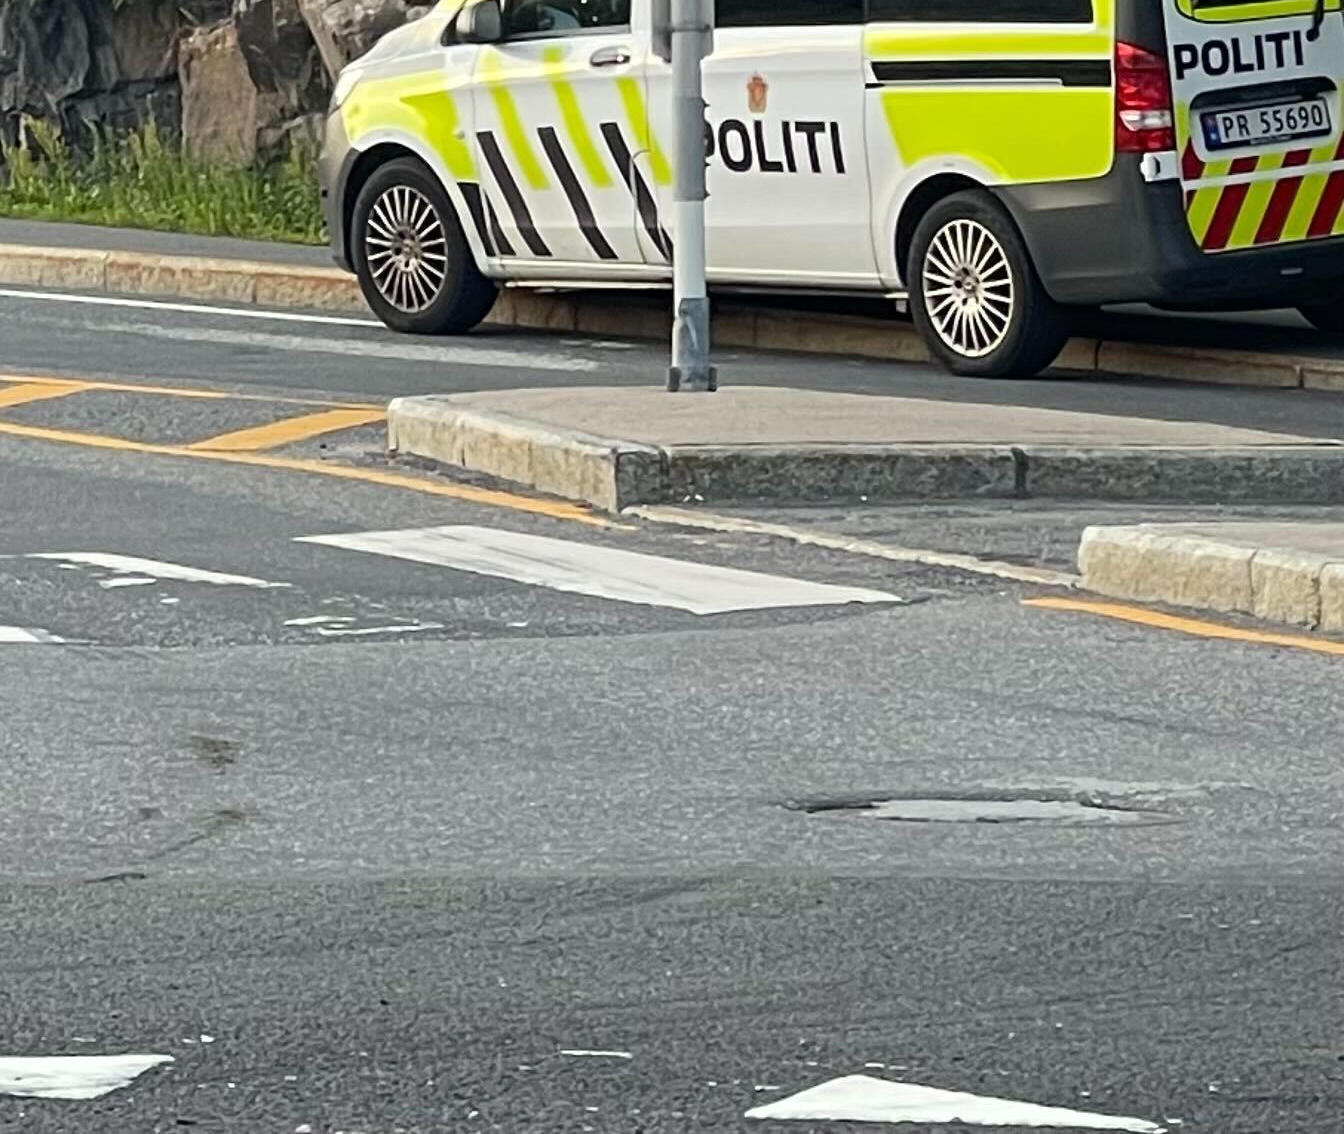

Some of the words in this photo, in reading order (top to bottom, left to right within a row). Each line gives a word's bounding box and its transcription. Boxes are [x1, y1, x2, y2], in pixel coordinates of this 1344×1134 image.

[1173, 30, 1304, 80] POLITI
[1222, 114, 1250, 139] PR
[1260, 105, 1323, 134] 55690
